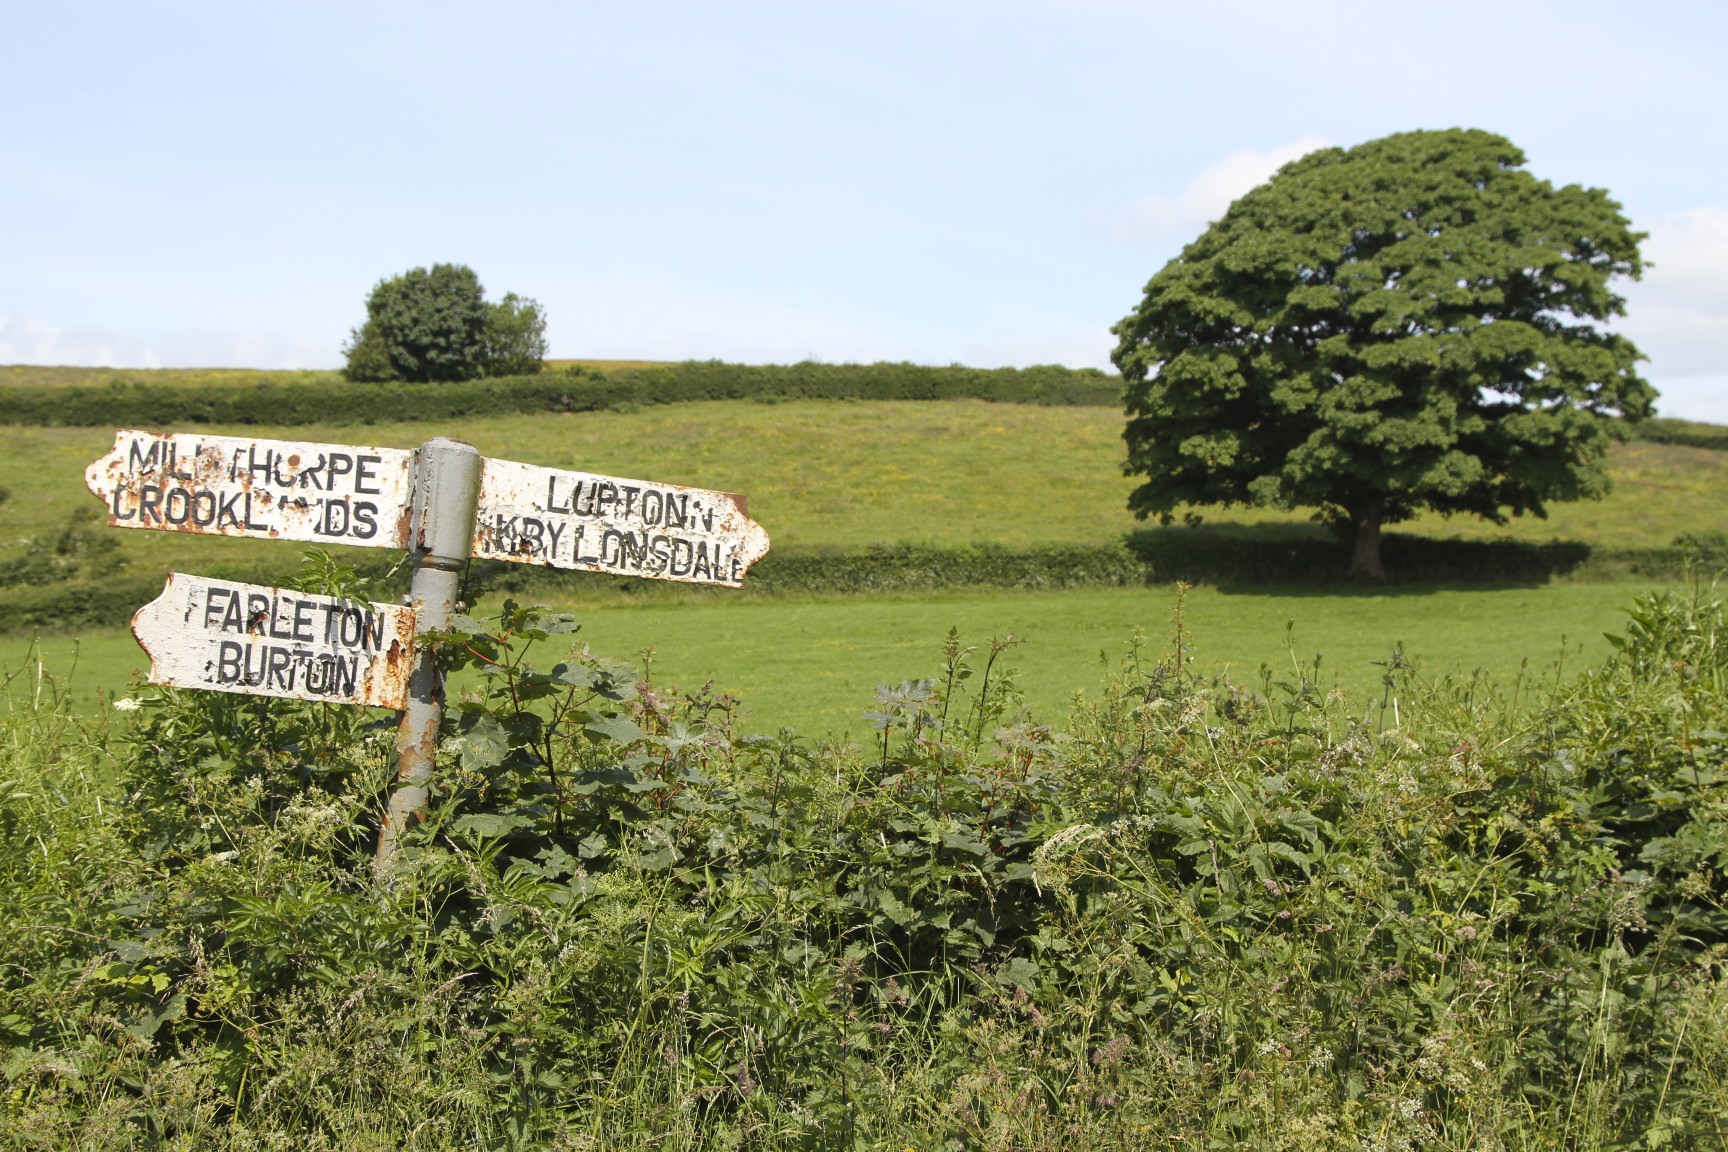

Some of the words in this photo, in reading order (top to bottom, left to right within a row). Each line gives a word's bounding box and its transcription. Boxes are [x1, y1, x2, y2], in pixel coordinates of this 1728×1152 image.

[129, 438, 382, 495] MILTHORPE
[112, 484, 379, 539] CROOKLDS
[204, 586, 385, 651] FARLETON
[217, 640, 359, 697] BURTON
